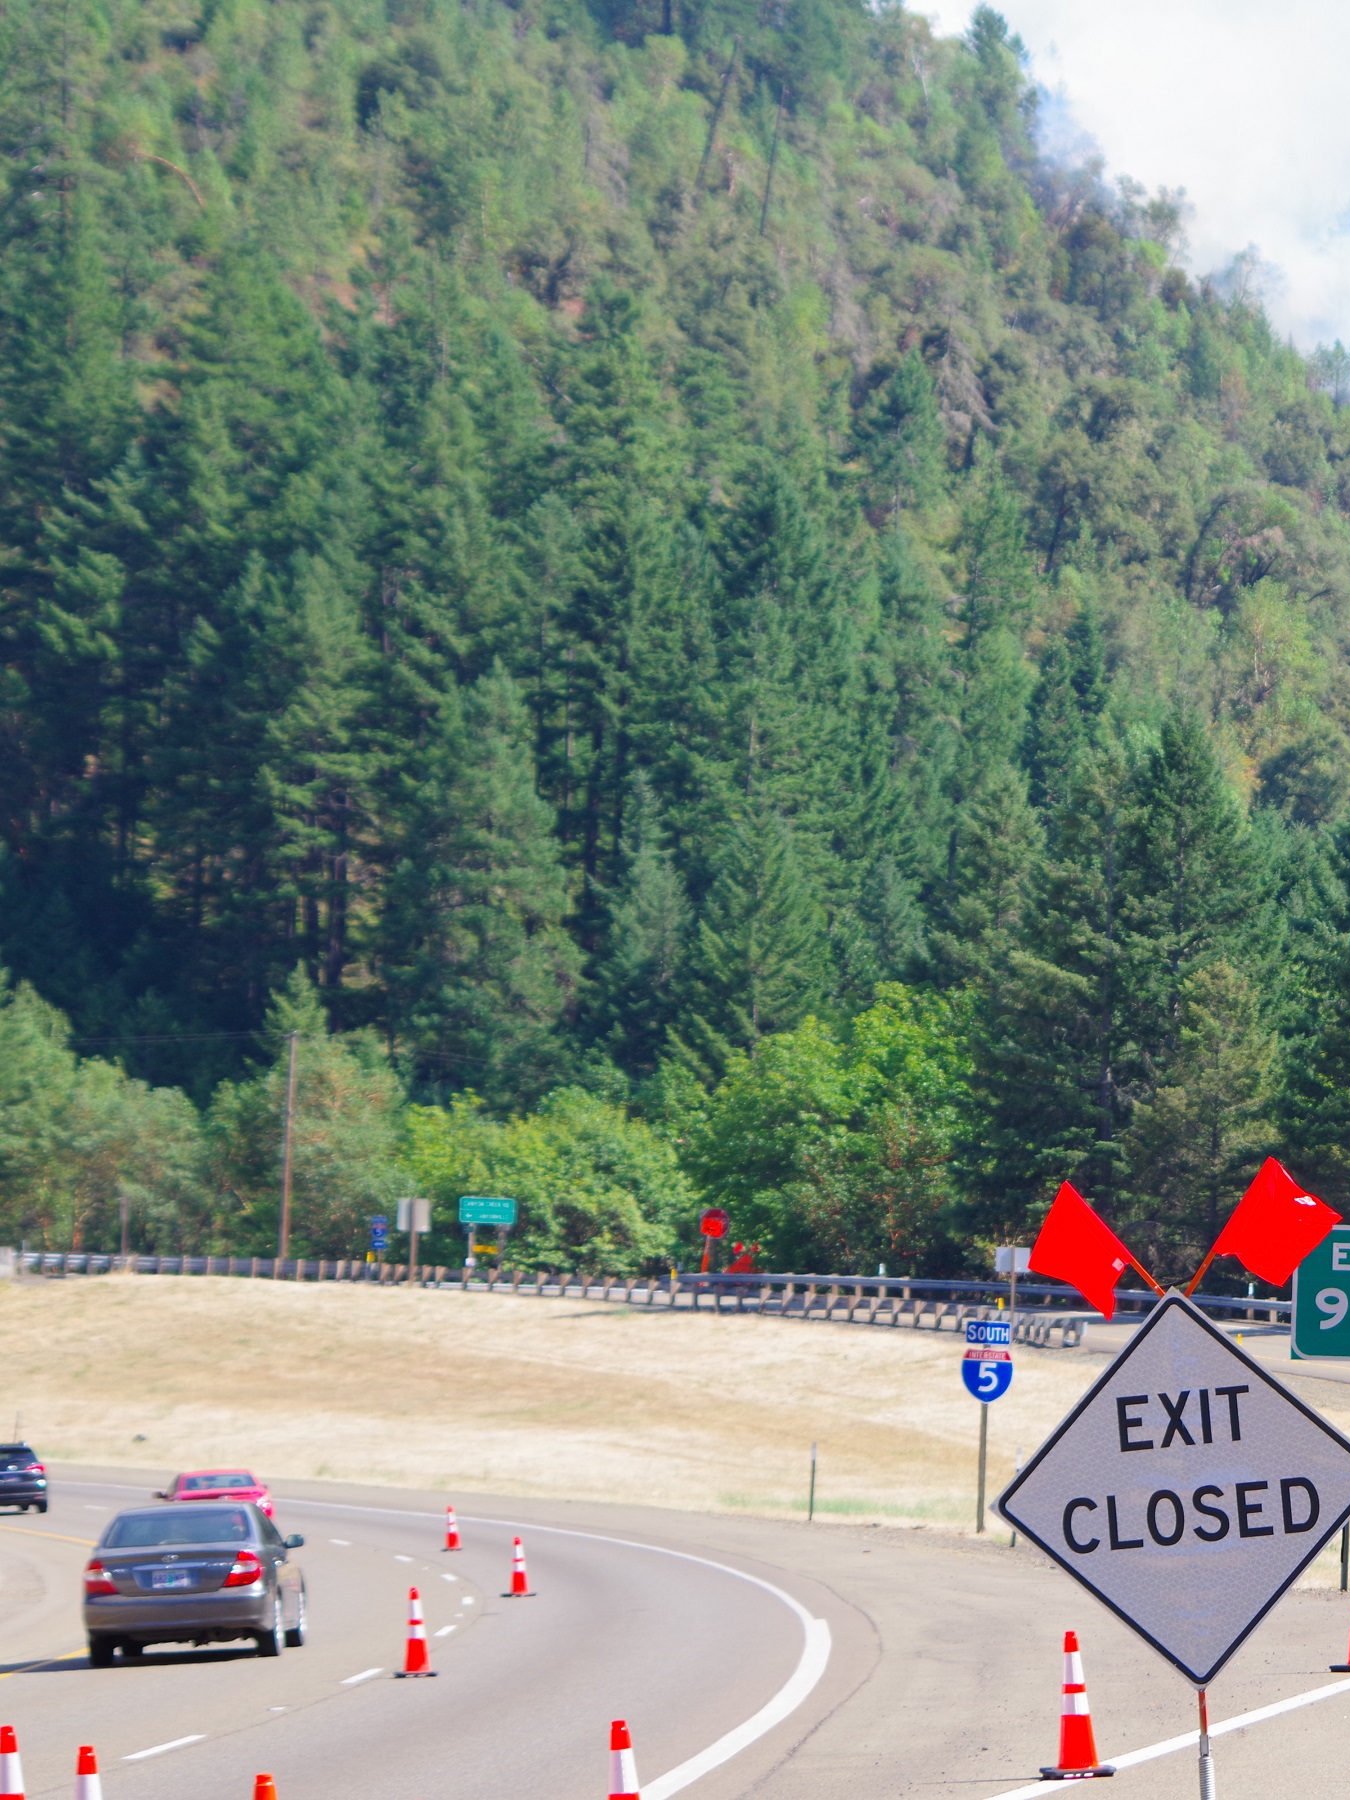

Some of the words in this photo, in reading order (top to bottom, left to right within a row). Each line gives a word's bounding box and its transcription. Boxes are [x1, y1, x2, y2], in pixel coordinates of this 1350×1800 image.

[967, 1324, 1010, 1342] SOUTH
[968, 1351, 1007, 1360] INTERSTATE
[978, 1361, 998, 1392] 5
[1116, 1385, 1249, 1452] EXIT
[1062, 1476, 1320, 1554] CLOSED
